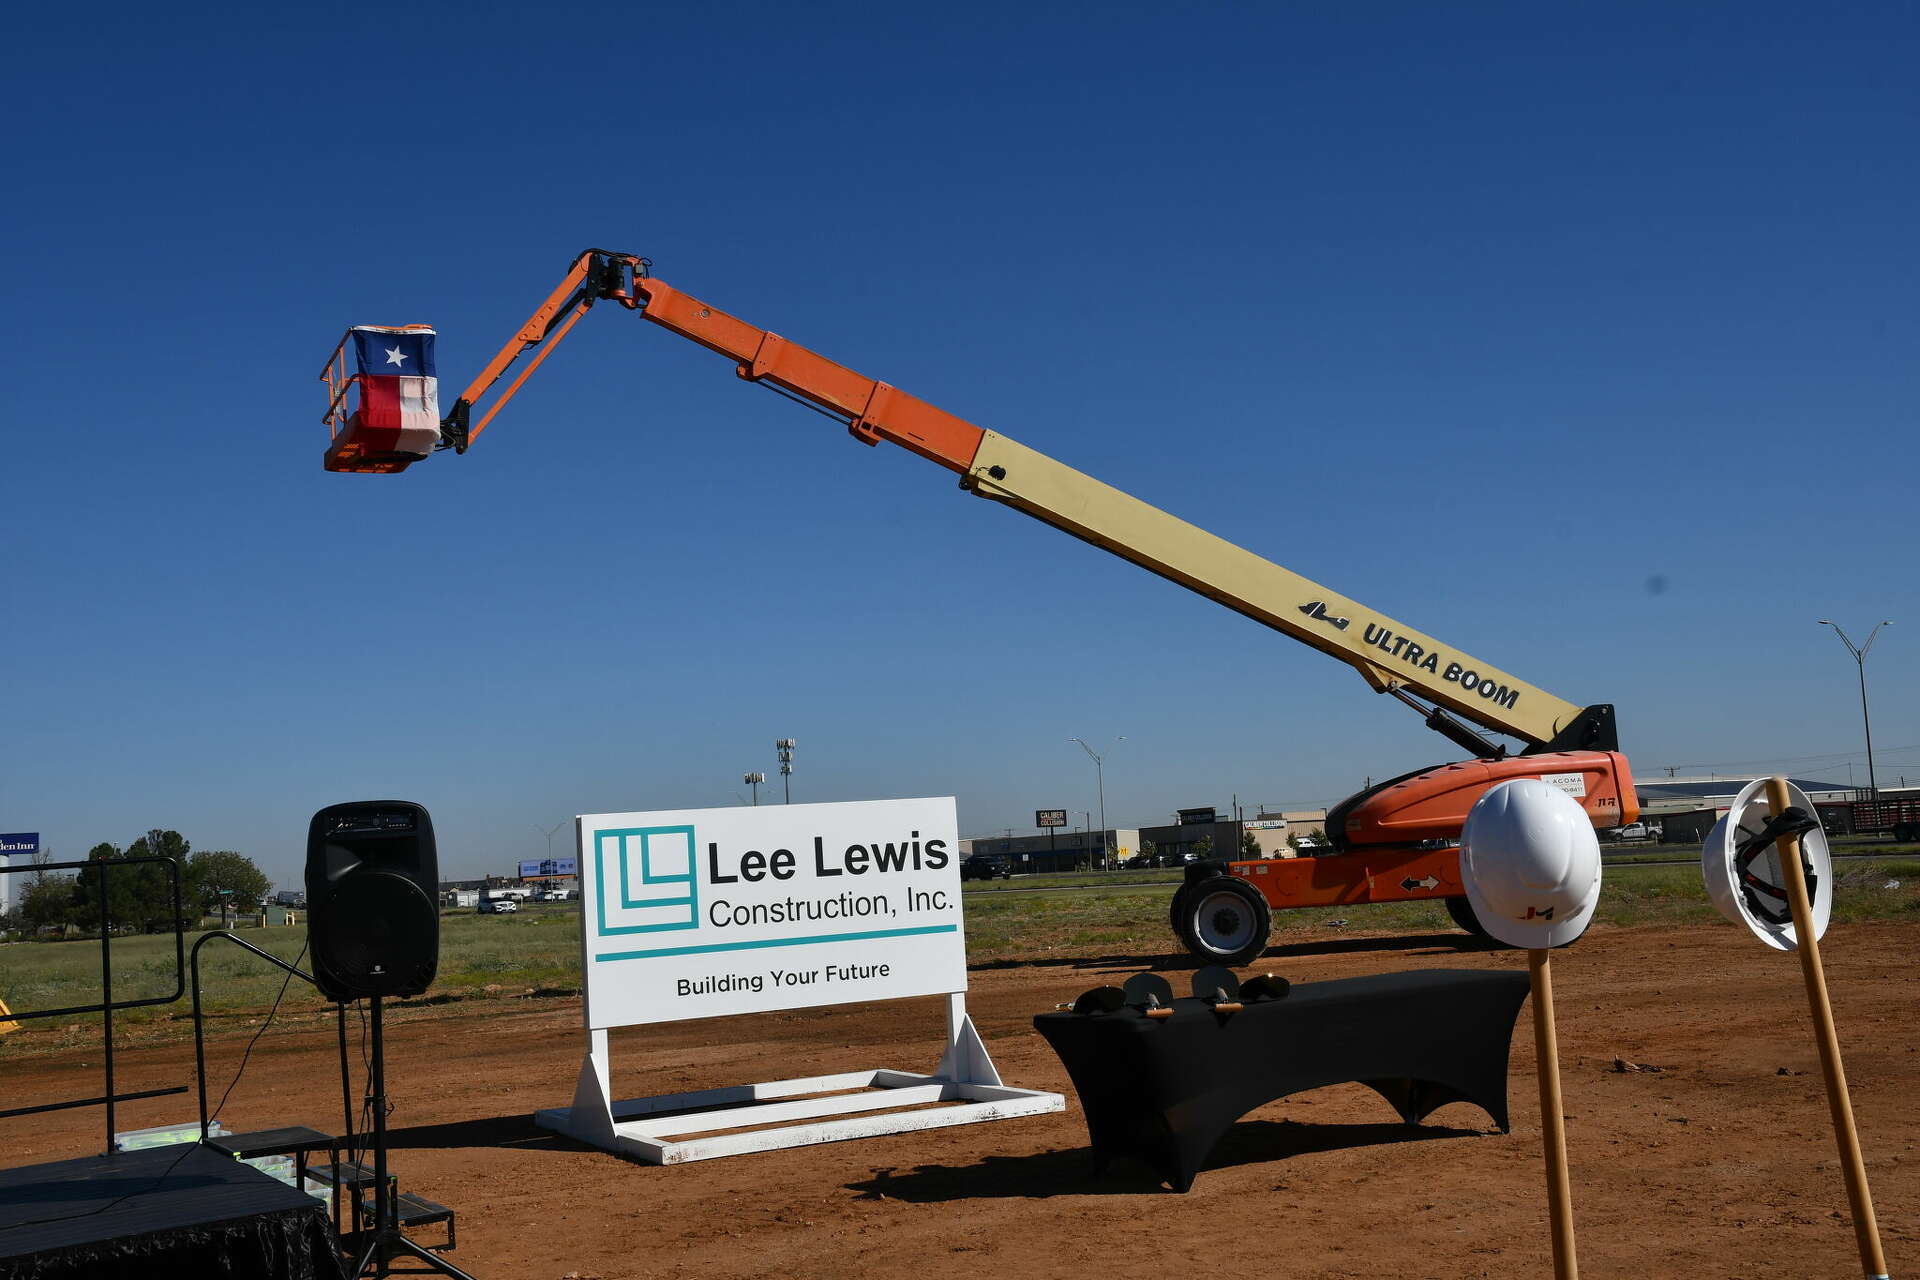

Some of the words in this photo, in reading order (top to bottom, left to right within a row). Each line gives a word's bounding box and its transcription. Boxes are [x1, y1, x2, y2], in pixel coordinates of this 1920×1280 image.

[1363, 623, 1438, 674] ULTRA
[1443, 662, 1520, 710] BOOM
[708, 842, 796, 884] Lee
[814, 831, 949, 877] Lewis
[709, 891, 896, 927] Construction,
[907, 887, 954, 912] Inc.
[677, 973, 763, 996] Building
[771, 968, 818, 987] Your
[826, 961, 890, 982] Future
